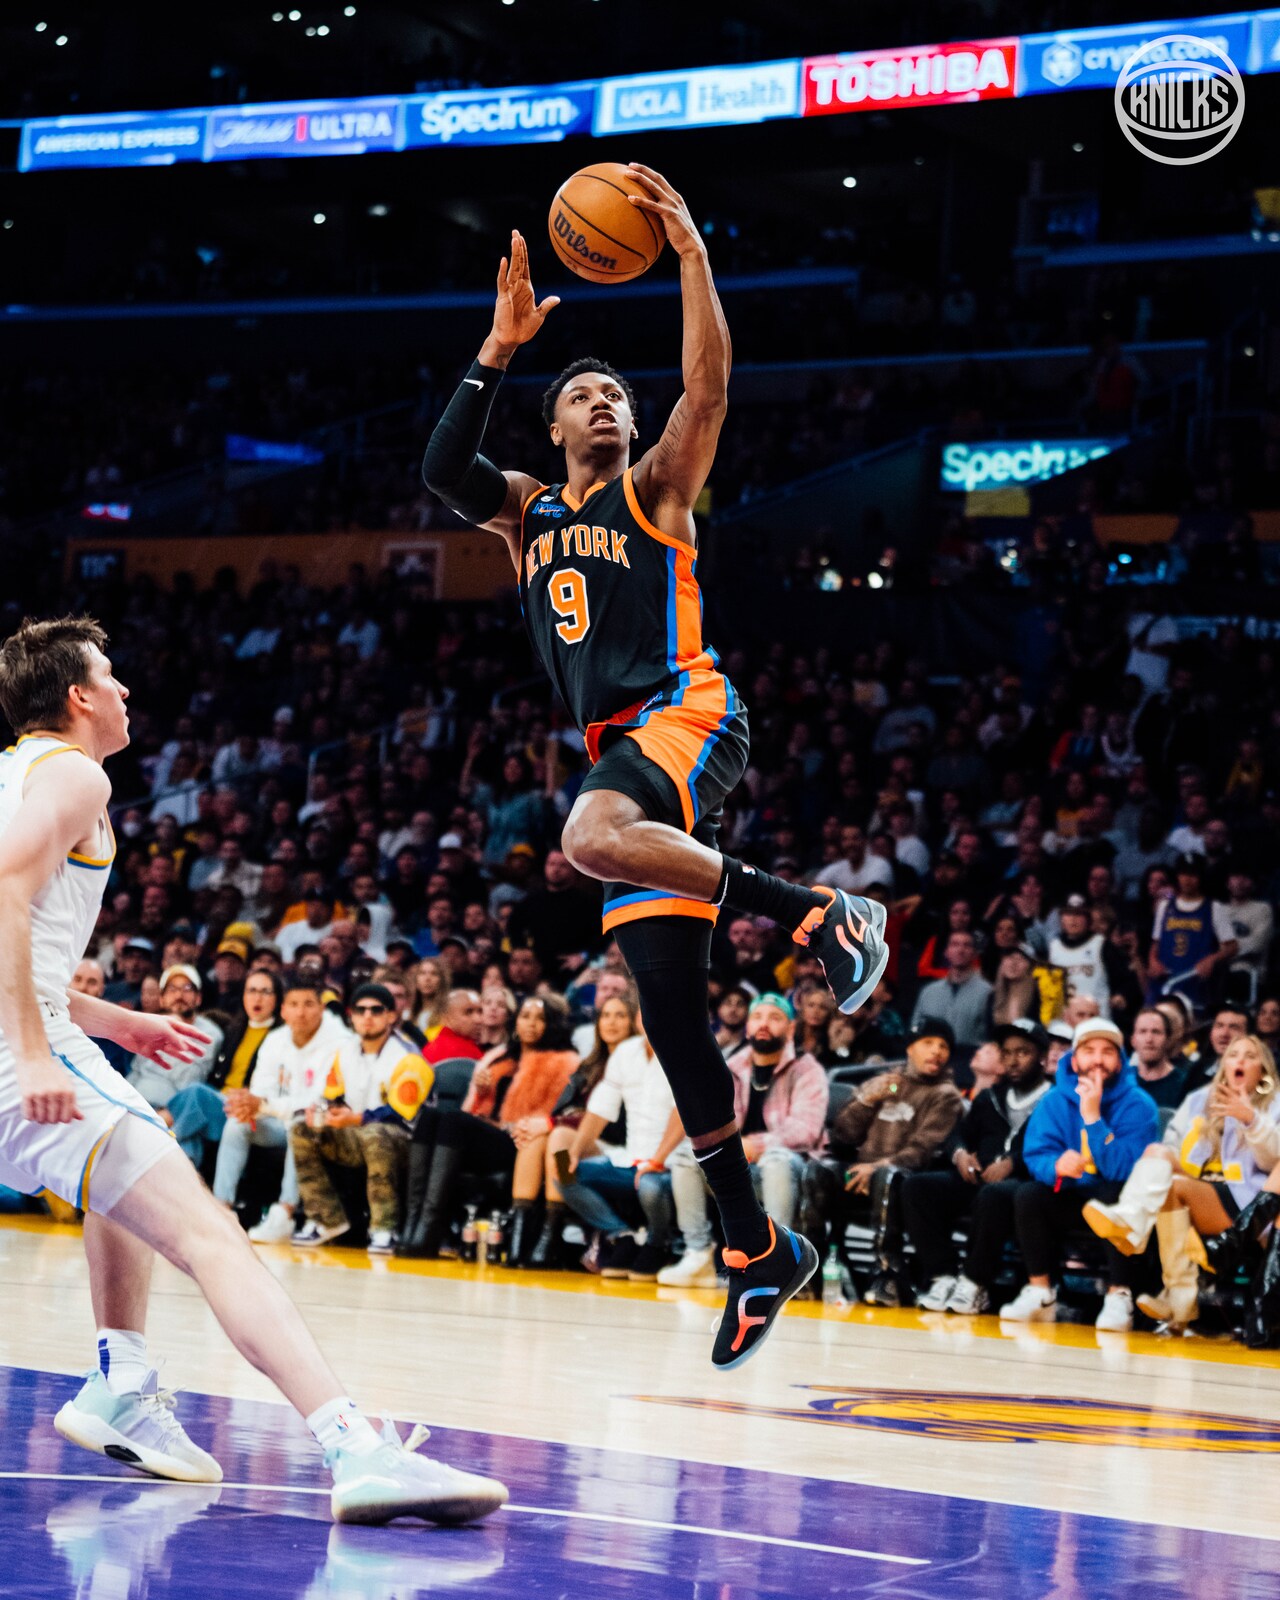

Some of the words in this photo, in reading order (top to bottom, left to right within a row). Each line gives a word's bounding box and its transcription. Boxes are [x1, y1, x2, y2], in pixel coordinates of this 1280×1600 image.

[619, 89, 682, 119] UCLA
[699, 79, 786, 114] Health
[809, 48, 1009, 105] TOSHIBA
[121, 125, 200, 149] EXPRESS
[310, 111, 392, 141] ULTRA
[420, 97, 573, 143] Spectrum
[553, 210, 619, 270] Wilson
[526, 531, 554, 588] NEW
[560, 524, 631, 569] YORK
[547, 567, 591, 645] 9
